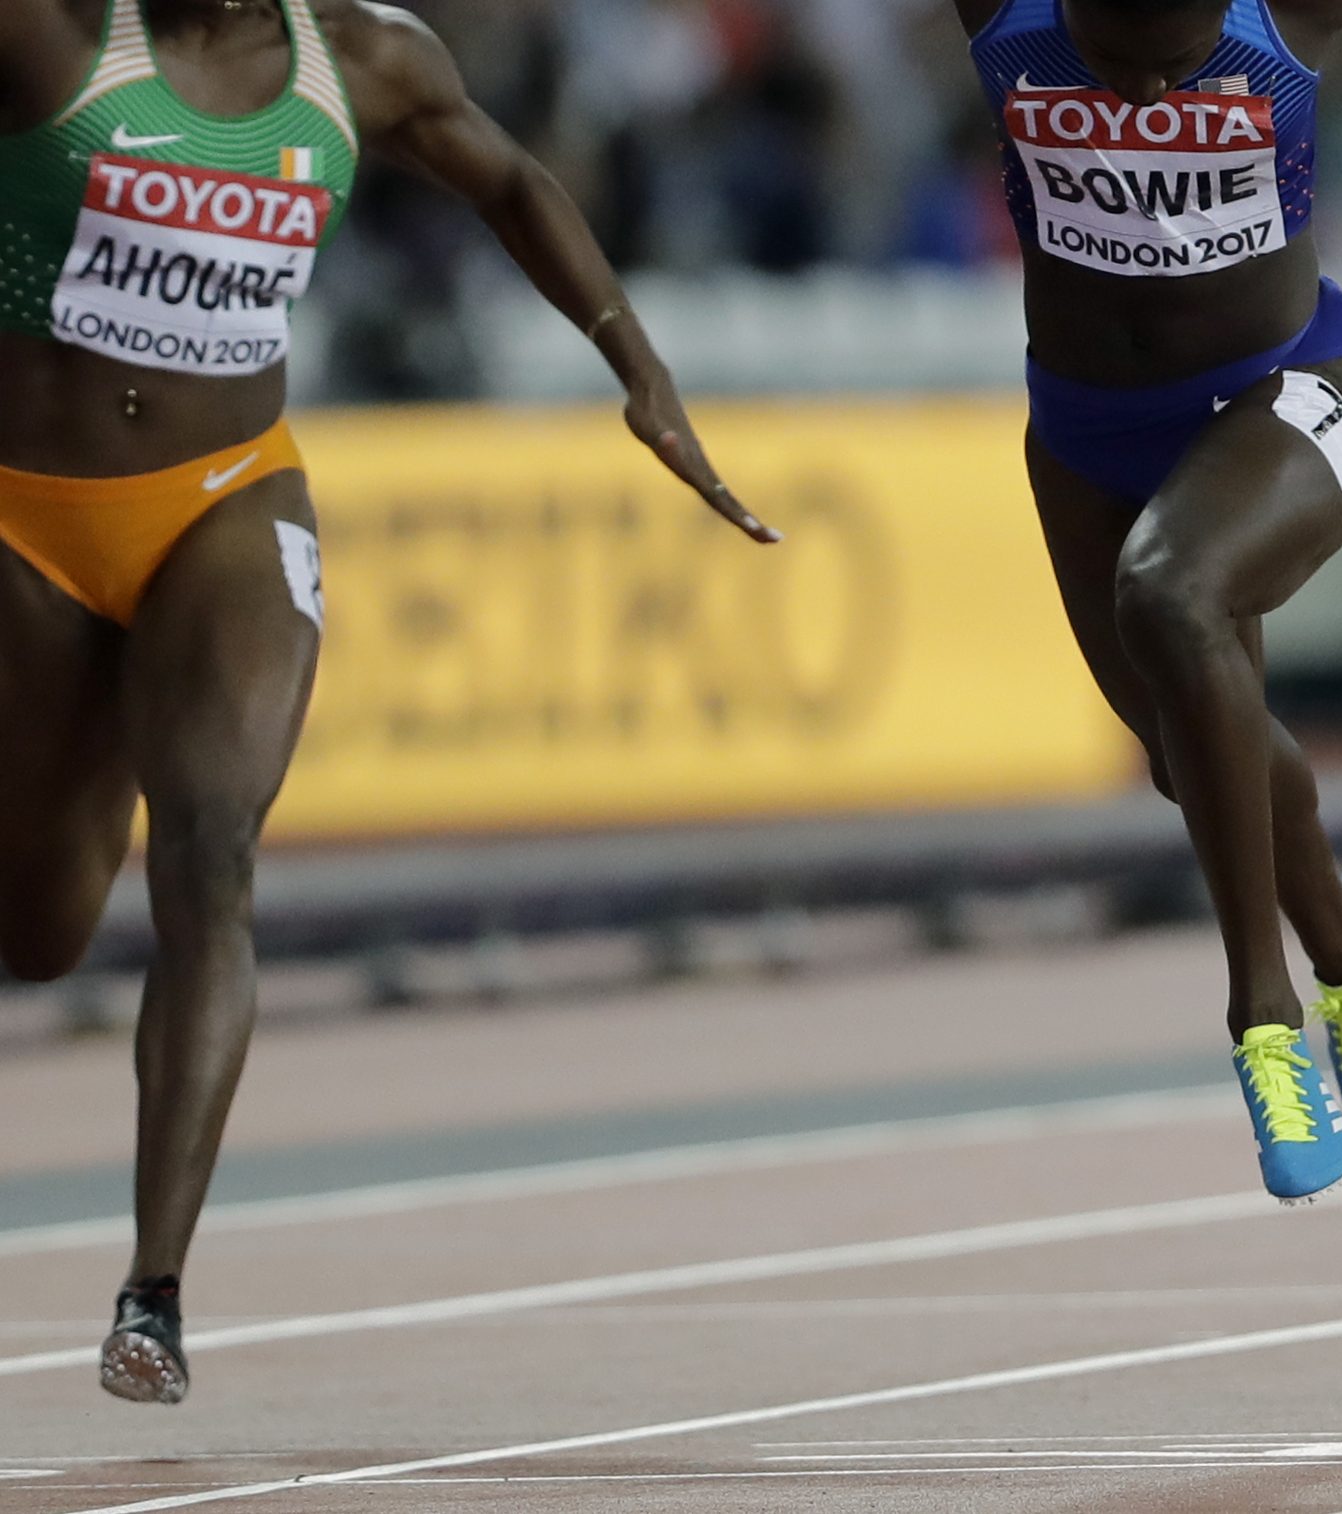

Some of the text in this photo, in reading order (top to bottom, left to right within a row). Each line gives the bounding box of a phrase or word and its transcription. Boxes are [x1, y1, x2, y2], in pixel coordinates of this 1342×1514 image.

[1013, 100, 1263, 145] TOYOTA
[99, 164, 317, 240] TOYOTA
[1035, 157, 1258, 221] BOWIE
[1046, 219, 1273, 268] LONDON 2017
[60, 306, 280, 364] LONDON 2017
